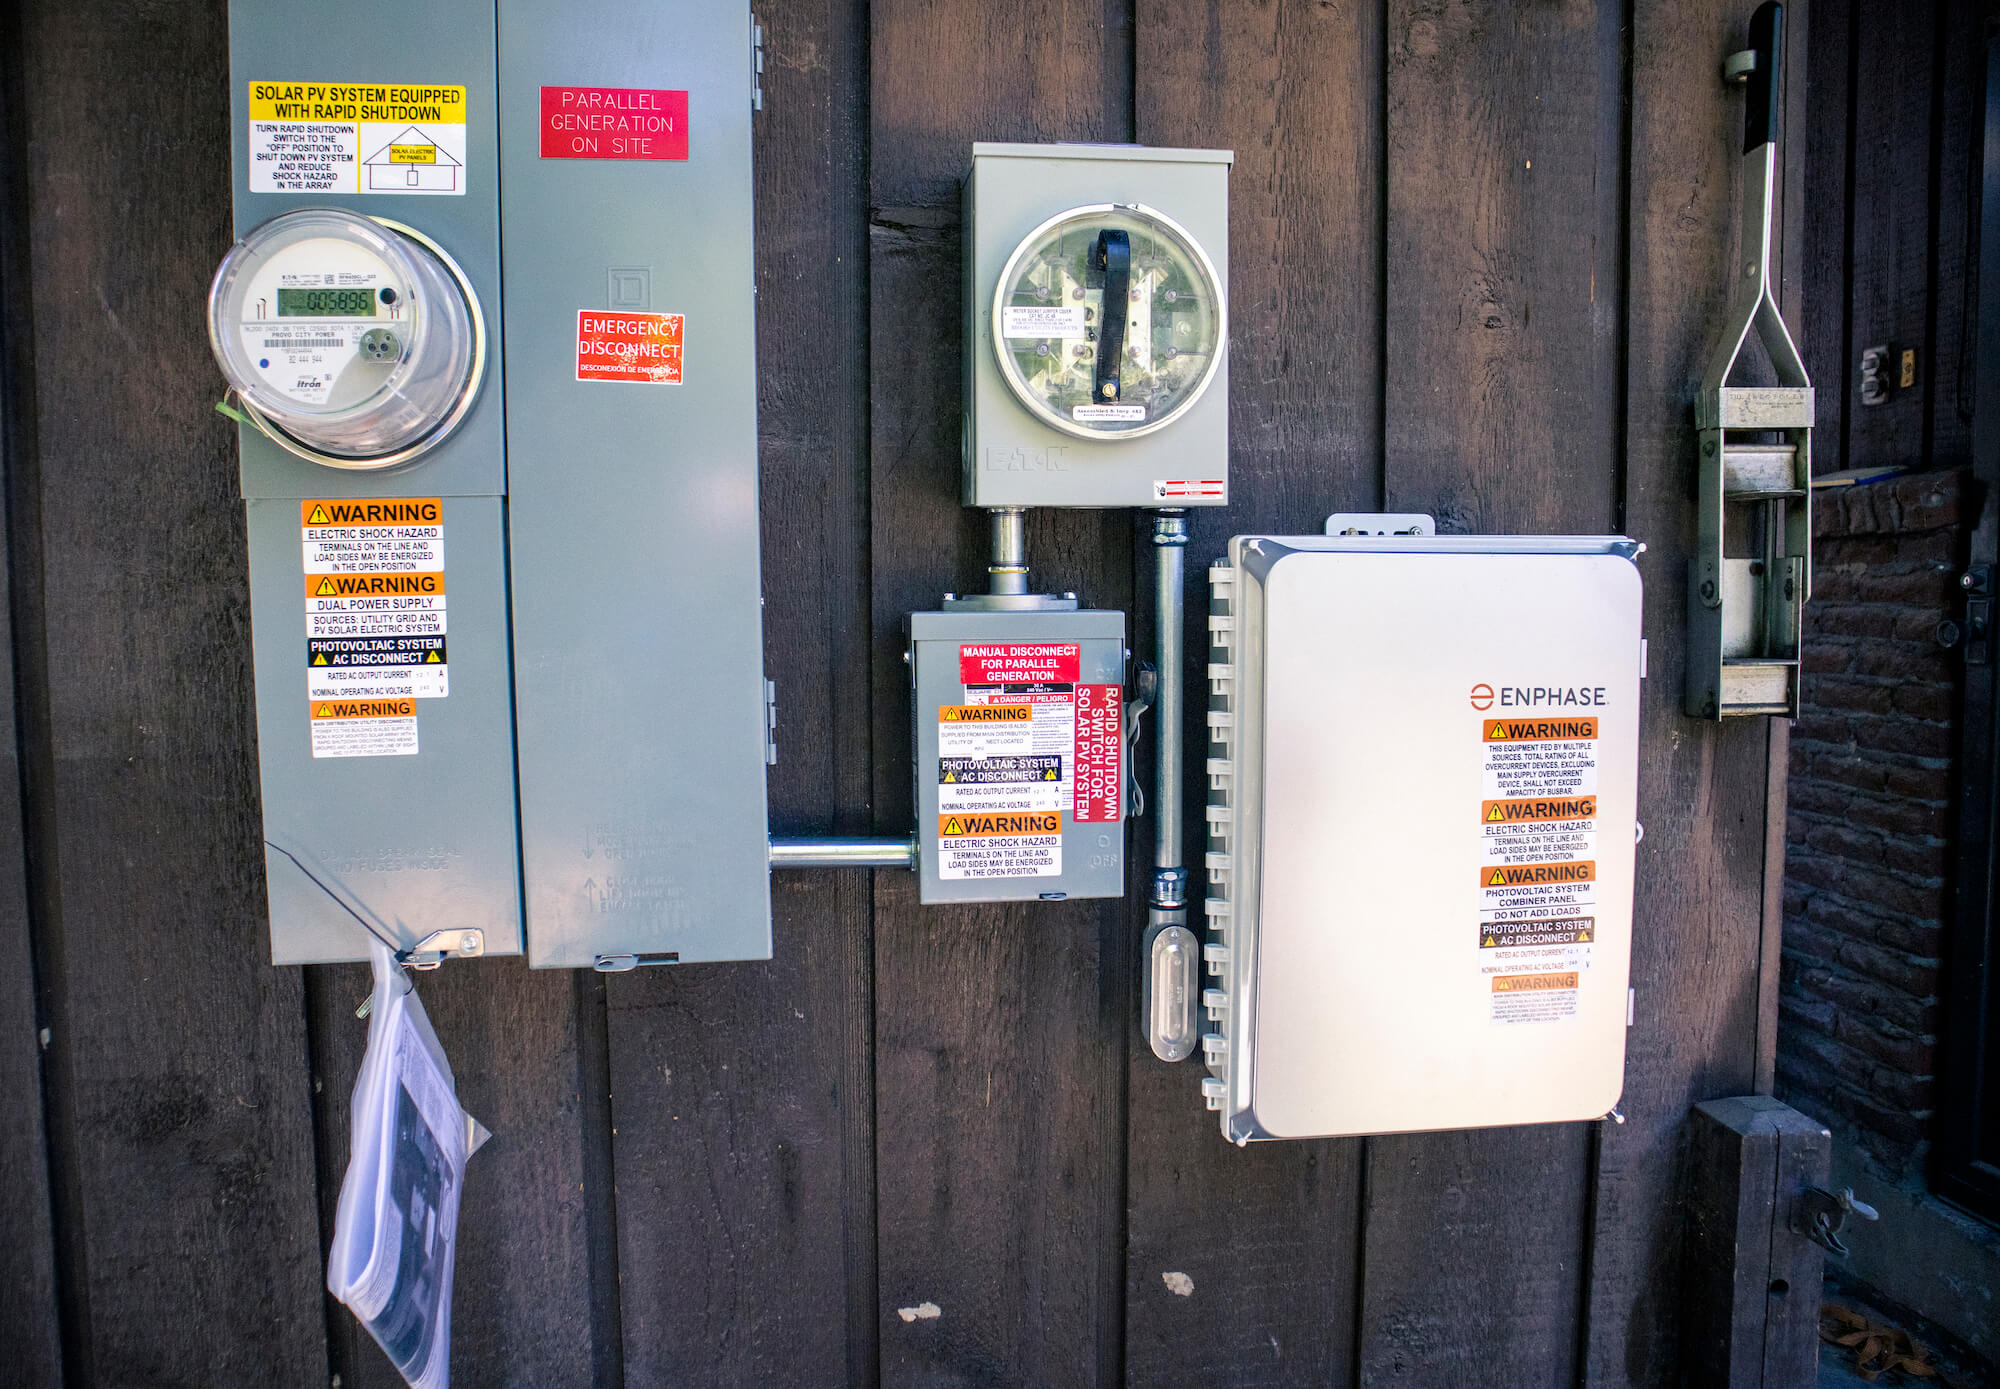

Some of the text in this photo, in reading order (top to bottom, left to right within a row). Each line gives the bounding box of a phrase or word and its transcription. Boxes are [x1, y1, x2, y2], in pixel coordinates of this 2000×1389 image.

[256, 86, 460, 104] SOLAR PV SYSTEM EQUIPPED
[563, 92, 661, 110] PARALLEL
[275, 104, 441, 120] WITH RAPID SHUTDOWN
[280, 125, 305, 133] RAPID
[551, 114, 673, 132] GENERATION
[321, 135, 336, 143] THE
[572, 137, 652, 154] ON SITE
[257, 153, 277, 161] SHUT
[320, 154, 353, 162] SYSTEM
[298, 163, 331, 171] REDUCE
[273, 172, 300, 180] SHOCK
[584, 319, 677, 337] EMERGENCY
[580, 341, 679, 358] DISCONNECT
[636, 366, 678, 374] EMERGENCIA
[331, 504, 437, 522] WARNING
[309, 528, 437, 539] ELECTRIC SHOCK HAZARD
[320, 543, 361, 551] TERMINALS
[393, 542, 409, 550] LINE
[412, 542, 428, 550] AND
[336, 553, 358, 561] SIDES
[390, 552, 433, 560] ENERGIZED
[343, 563, 356, 571] THE
[382, 562, 416, 570] POSITION
[337, 577, 435, 593] WARNING
[318, 598, 433, 610] DUAL POWER SUPPLY
[314, 614, 437, 624] SOURCES: UTILITY GRID AND
[315, 624, 440, 634] PV SOLAR ELECTRIC SYSTEM
[311, 639, 442, 651] PHOTOVOLTAIC SYSTEM
[964, 647, 1077, 656] MANUAL DISCONNECT
[333, 653, 423, 664] AC DISCONNECT
[981, 660, 1059, 668] FOR PARALLEL
[987, 671, 1054, 680] GENERATION
[1501, 688, 1605, 705] ENPHASE
[334, 703, 410, 716] WARNING
[960, 709, 1026, 720] WARNING
[1509, 723, 1592, 738] WARNING
[1077, 688, 1090, 819] SOLAR PV SYSTEM
[1091, 708, 1104, 799] SWITCH FOR
[1104, 688, 1118, 819] RAPID SHUTDOWN
[1503, 744, 1538, 752] EQUIPMENT
[942, 758, 1058, 770] PHOTOVOLTAIC SYSTEM
[961, 771, 1041, 781] AC DISCONNECT
[1506, 801, 1592, 818] WARNING
[964, 816, 1056, 832] WARNING
[1486, 822, 1592, 835] ELECTRIC SHOCK HAZARD
[944, 837, 1056, 848] ELECTRIC SHOCK HAZARD
[1507, 865, 1588, 883] WARNING
[1486, 885, 1590, 897] PHOTOVOLTAIC SYSTEM
[1500, 895, 1576, 906] COMBINER PANEL
[1510, 910, 1526, 918] NOT
[1530, 909, 1549, 917] ADD
[1551, 907, 1580, 916] LOADS
[1483, 921, 1591, 934] PHOTOVOLTAIC SYSTEM
[1500, 933, 1575, 944] AC DISCONNECT
[1511, 976, 1574, 989] WARNING
